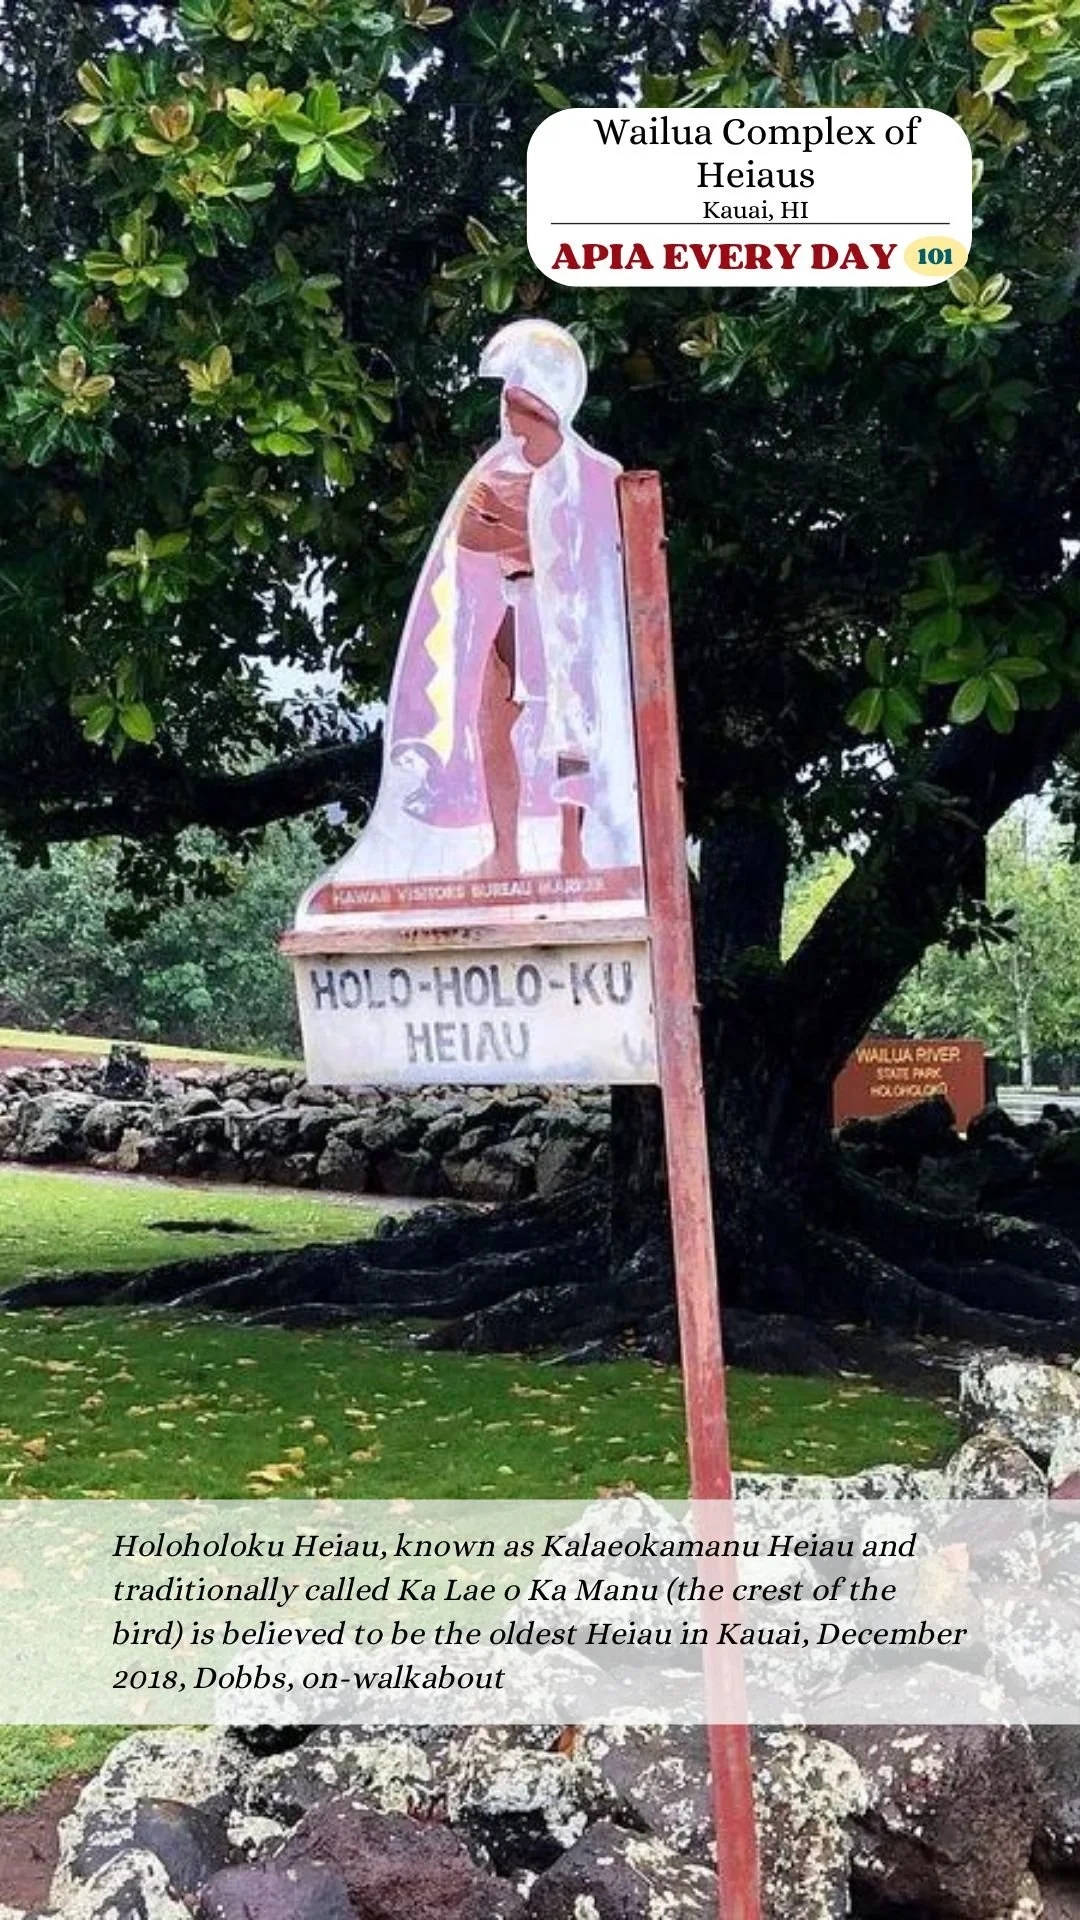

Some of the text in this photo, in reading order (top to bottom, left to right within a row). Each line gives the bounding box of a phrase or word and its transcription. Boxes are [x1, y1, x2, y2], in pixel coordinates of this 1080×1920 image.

[471, 880, 531, 898] BUREAU
[310, 960, 634, 1010] HOLO-HOLO-KU
[406, 1020, 531, 1064] HEIAU
[856, 1046, 961, 1064] WAILUA RIVER
[876, 1067, 943, 1081] STATE PARK
